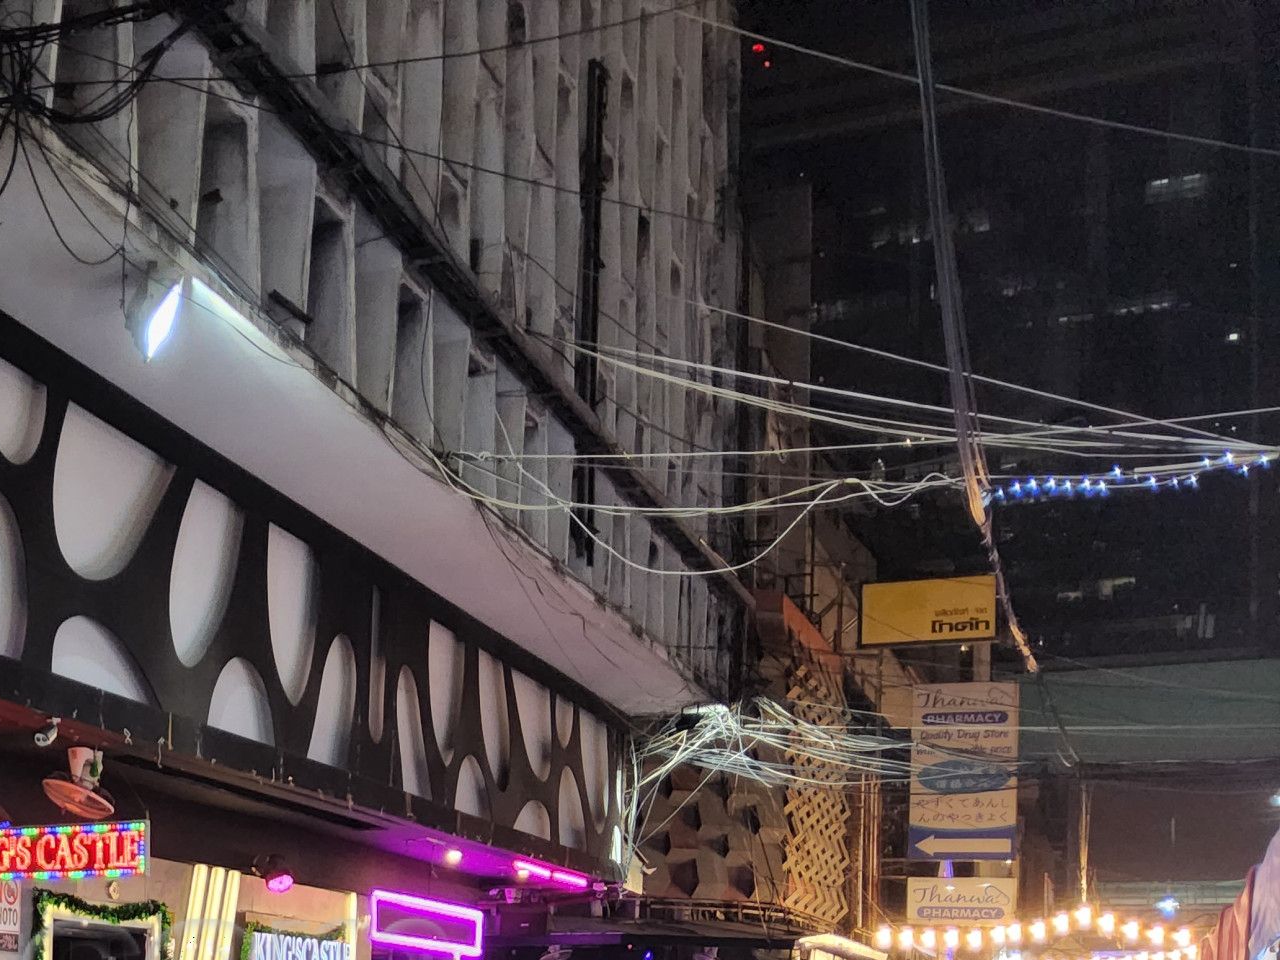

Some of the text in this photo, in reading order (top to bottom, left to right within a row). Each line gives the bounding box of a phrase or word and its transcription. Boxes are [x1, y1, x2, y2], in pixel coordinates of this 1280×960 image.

[931, 617, 990, 634] โกดัก
[927, 713, 1002, 724] PHARMACY
[35, 829, 140, 871] CASTLE
[913, 884, 1001, 905] Thanwa
[923, 907, 998, 919] PHARMACY
